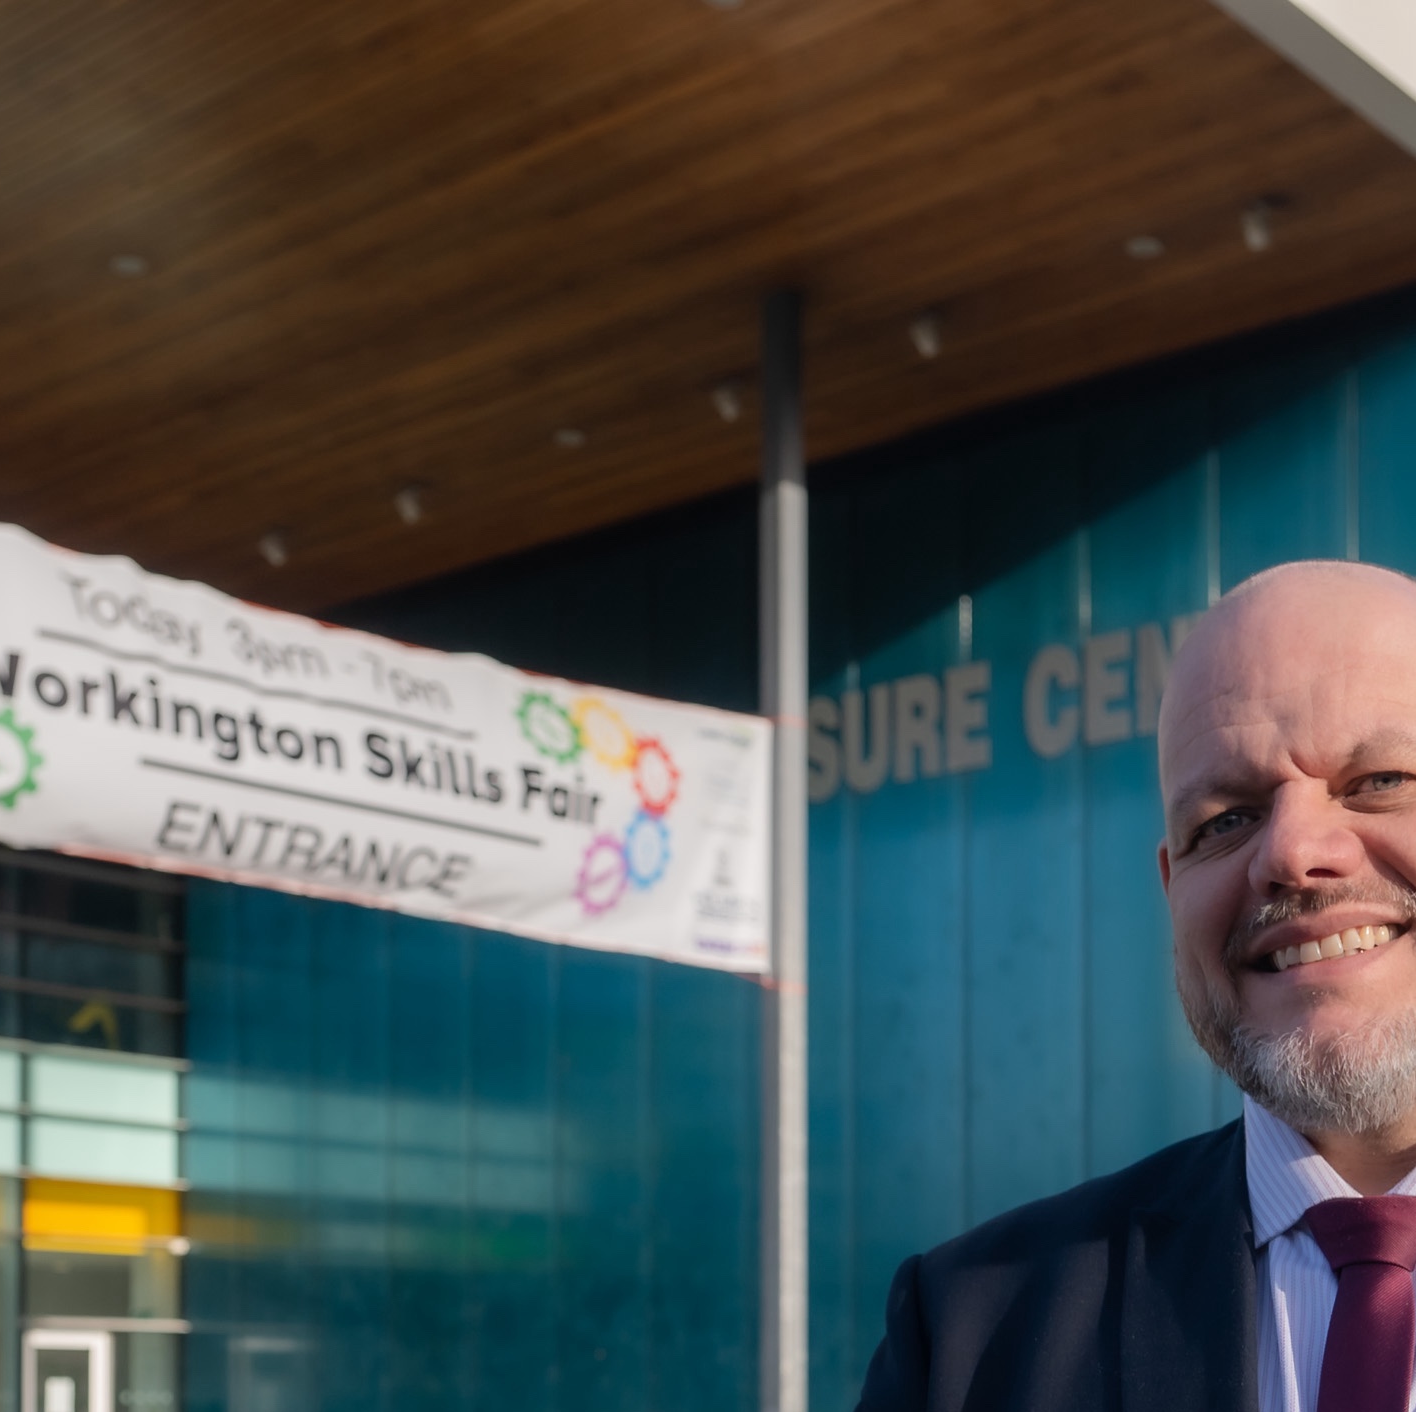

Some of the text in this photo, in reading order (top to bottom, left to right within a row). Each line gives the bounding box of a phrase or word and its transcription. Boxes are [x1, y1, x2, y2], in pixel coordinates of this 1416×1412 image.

[58, 568, 203, 659] Today
[225, 616, 331, 678] 3pm
[1023, 610, 1207, 759] CEN
[365, 731, 503, 804] Skills
[518, 765, 602, 826] Fair
[156, 799, 474, 897] ENTRANCE
